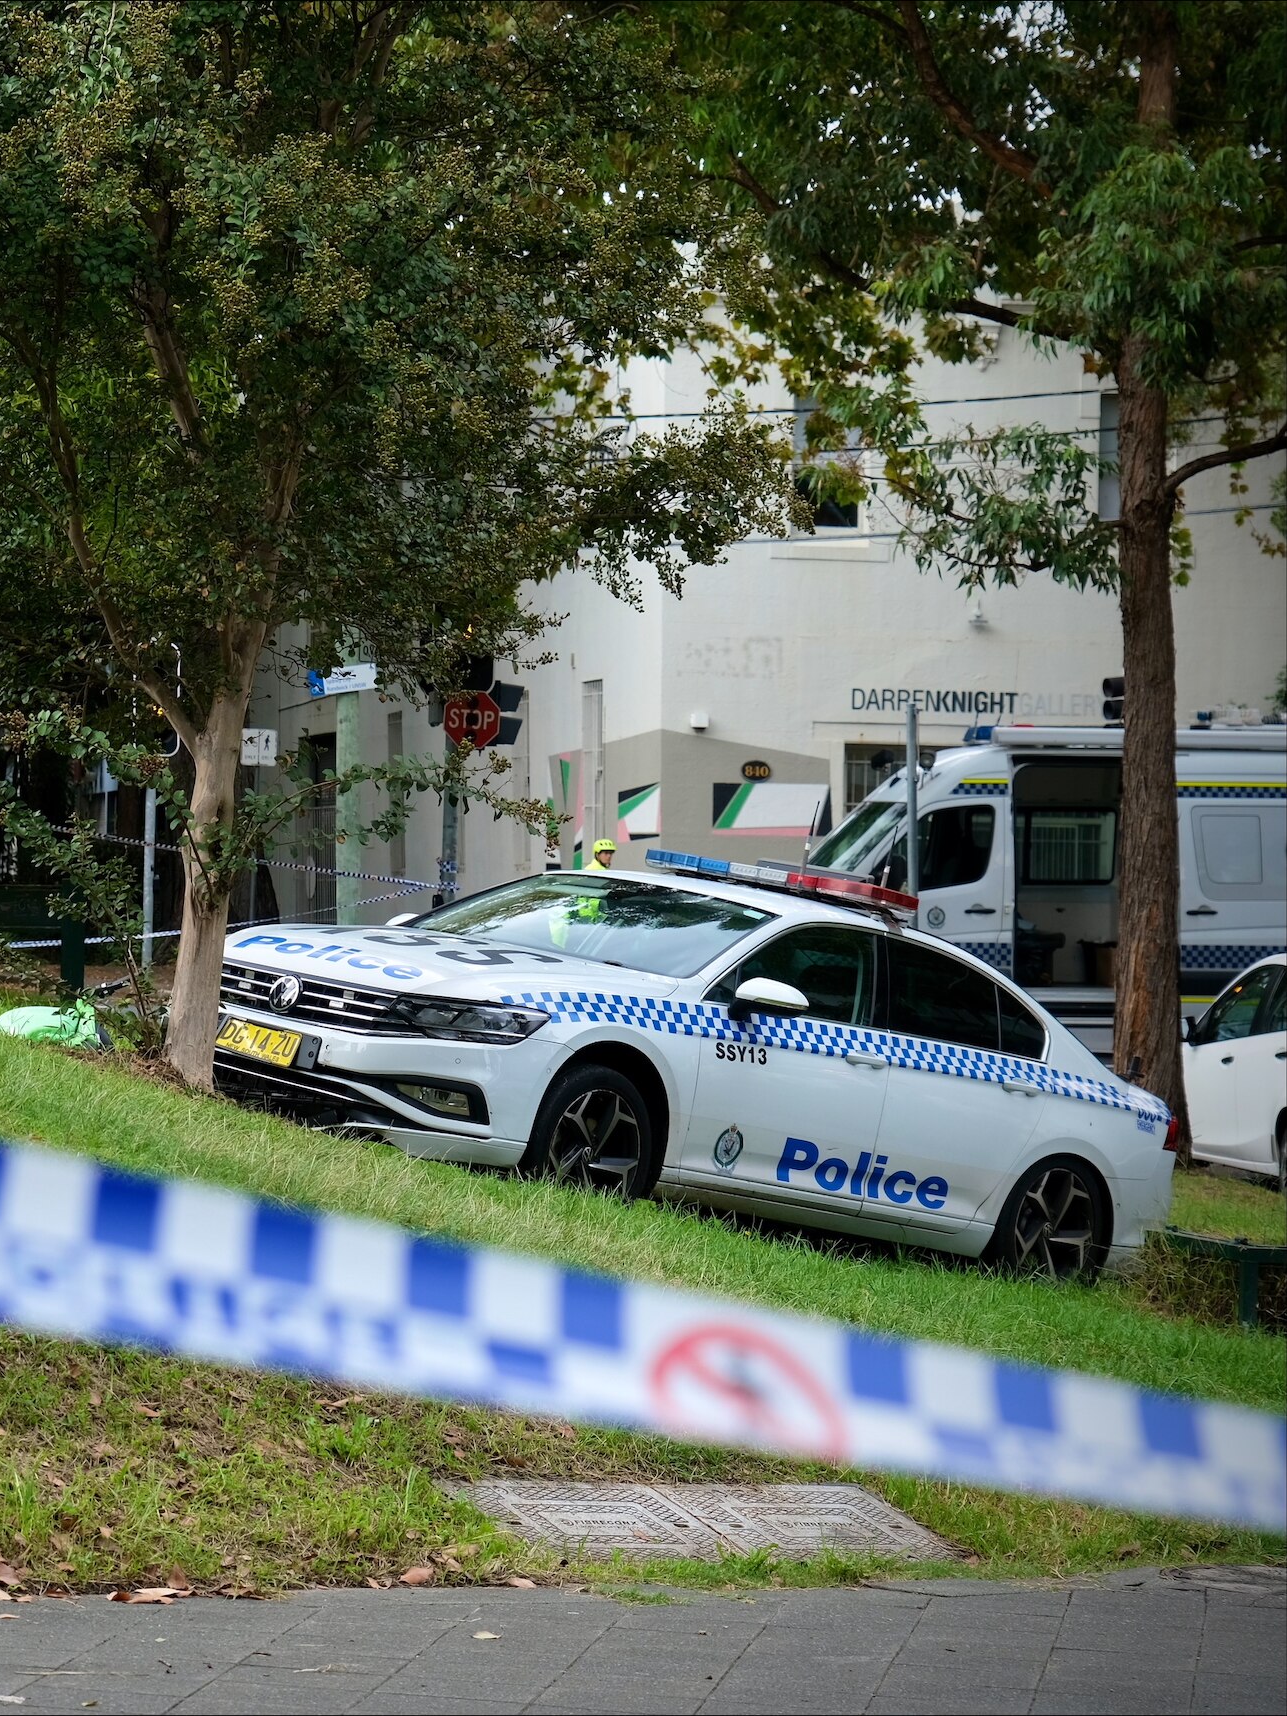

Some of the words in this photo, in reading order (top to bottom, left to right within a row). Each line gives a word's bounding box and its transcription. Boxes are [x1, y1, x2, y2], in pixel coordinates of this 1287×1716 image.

[936, 690, 1018, 714] KNIGHT
[448, 708, 495, 730] STOP
[234, 935, 423, 980] Police
[716, 1041, 767, 1065] SSY13
[776, 1137, 949, 1209] Police
